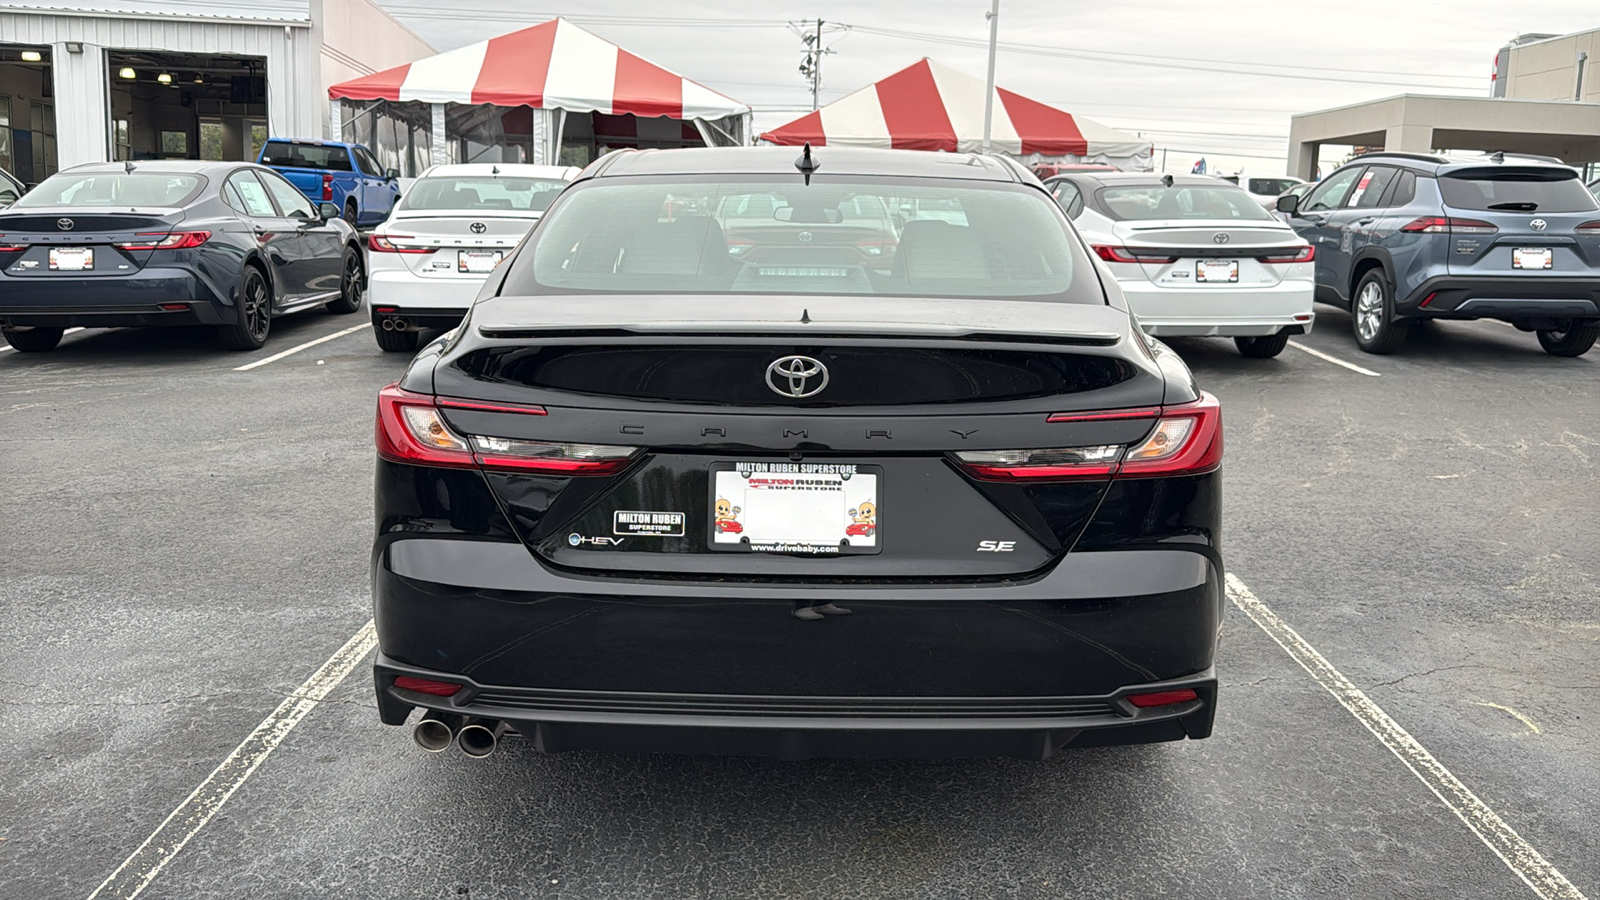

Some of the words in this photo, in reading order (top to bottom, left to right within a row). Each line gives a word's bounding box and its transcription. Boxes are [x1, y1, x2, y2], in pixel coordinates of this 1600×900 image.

[619, 425, 980, 440] CAMRY
[735, 462, 768, 473] MILTON
[770, 463, 799, 473] RUBEN
[800, 464, 857, 474] SUPERSTORE
[618, 513, 651, 524] MILTON
[652, 514, 682, 525] RUBEN
[580, 536, 625, 545] HEV
[976, 540, 1017, 552] SE
[751, 545, 839, 553] www.drivebaby.com
